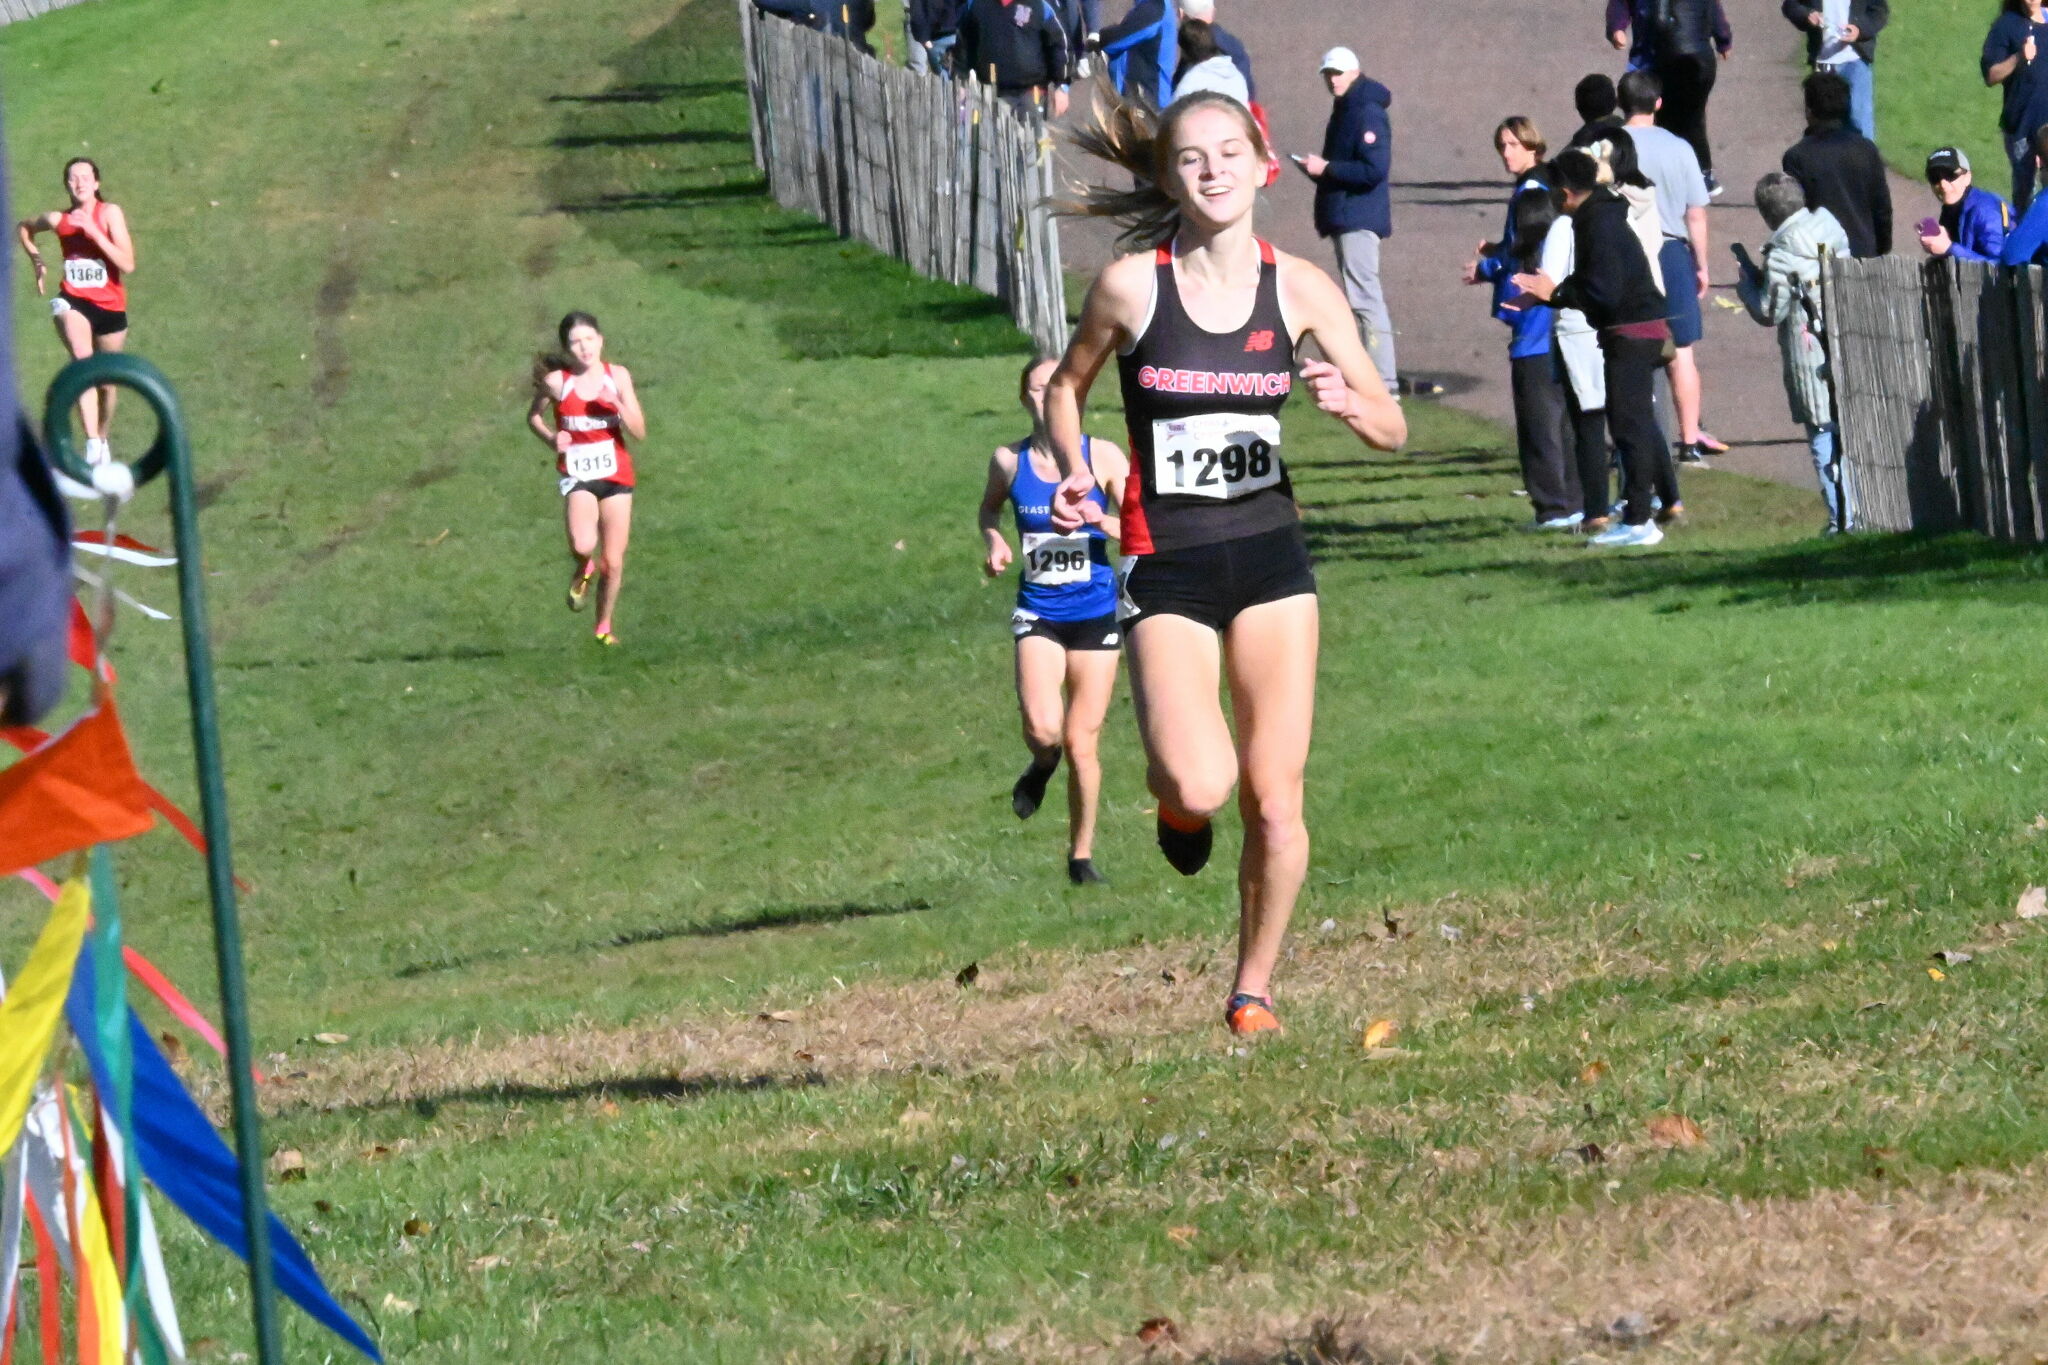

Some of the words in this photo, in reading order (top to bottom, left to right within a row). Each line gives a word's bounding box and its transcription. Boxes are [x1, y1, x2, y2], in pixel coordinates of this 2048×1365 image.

[1138, 365, 1291, 397] GREENWICH
[573, 453, 612, 472] 1315
[1166, 438, 1271, 488] 1298
[1026, 548, 1085, 572] 1296
